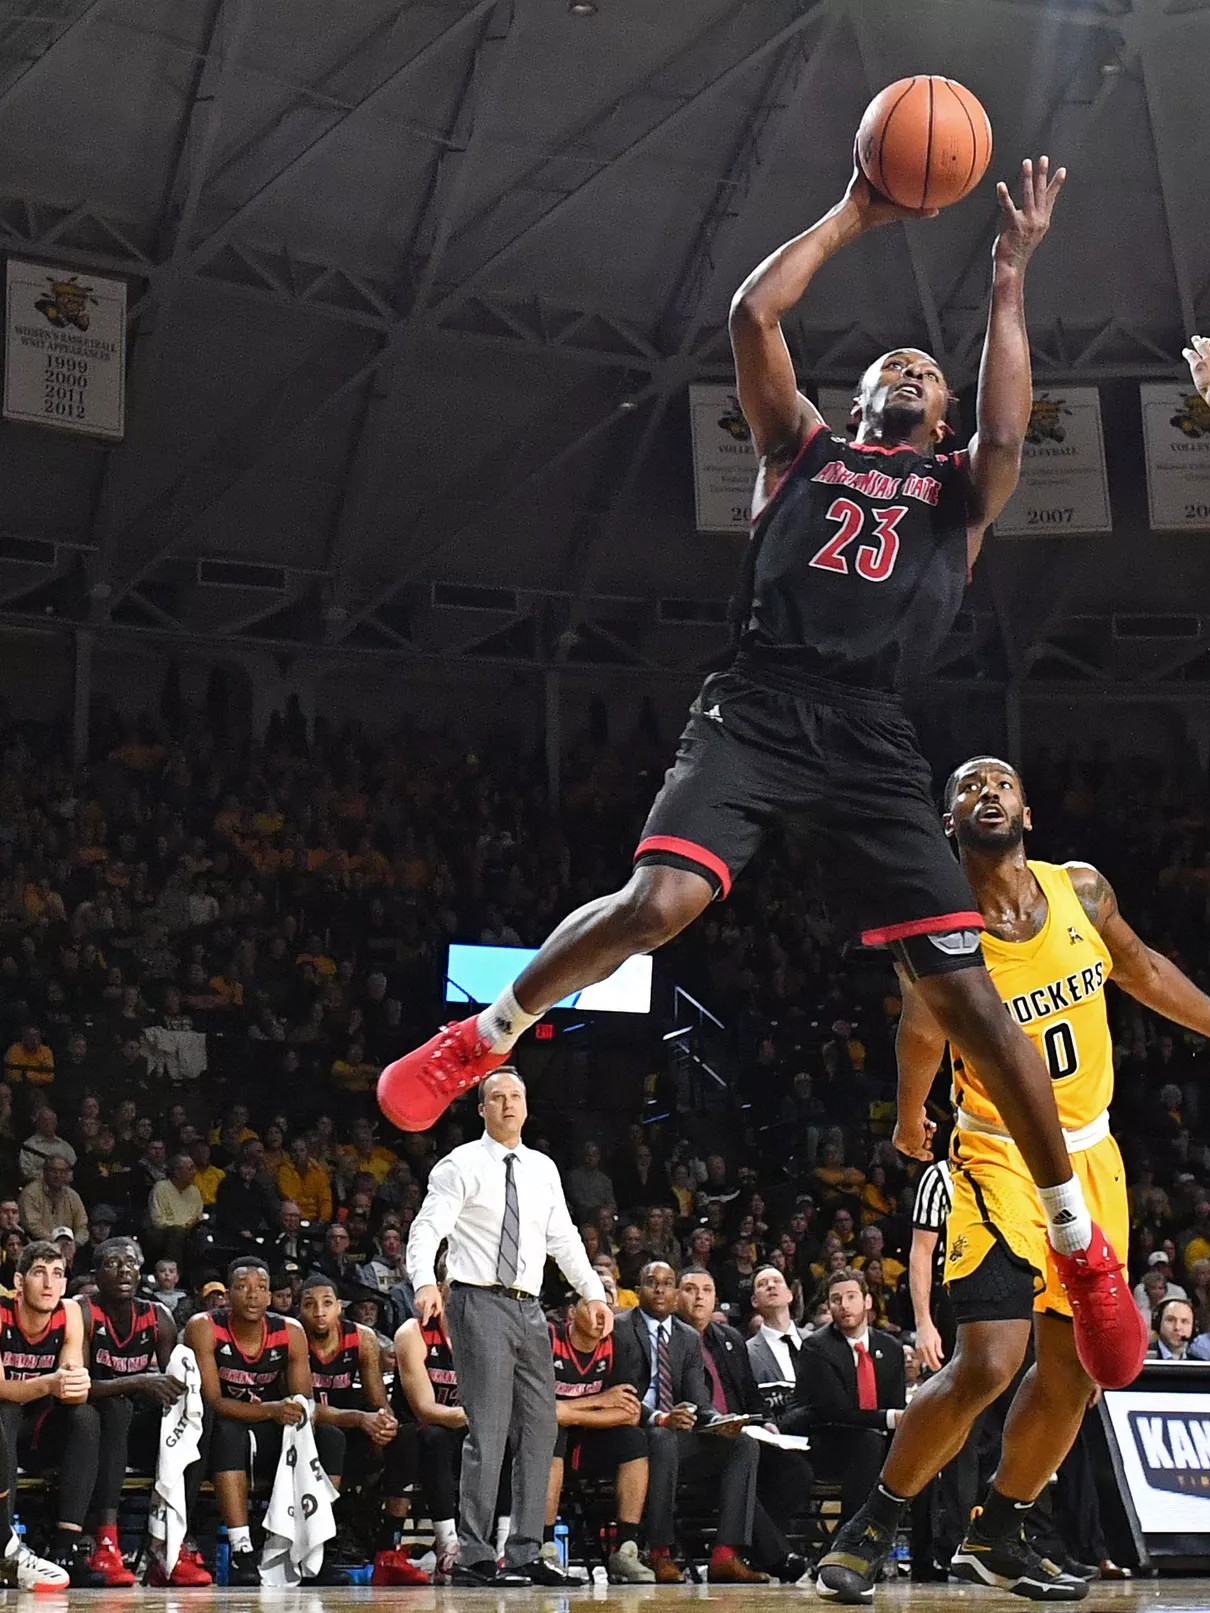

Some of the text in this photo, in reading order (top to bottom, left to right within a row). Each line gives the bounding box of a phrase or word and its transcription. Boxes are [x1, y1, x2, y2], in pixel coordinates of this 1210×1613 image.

[46, 355, 88, 373] 1999
[44, 369, 88, 388] 2000
[44, 385, 84, 404] 2011
[44, 399, 86, 419] 2012
[901, 472, 943, 507] TATE
[1027, 508, 1075, 525] 2007
[808, 497, 909, 582] 23
[1003, 961, 1105, 1026] OCKERS
[1042, 1019, 1079, 1083] 0
